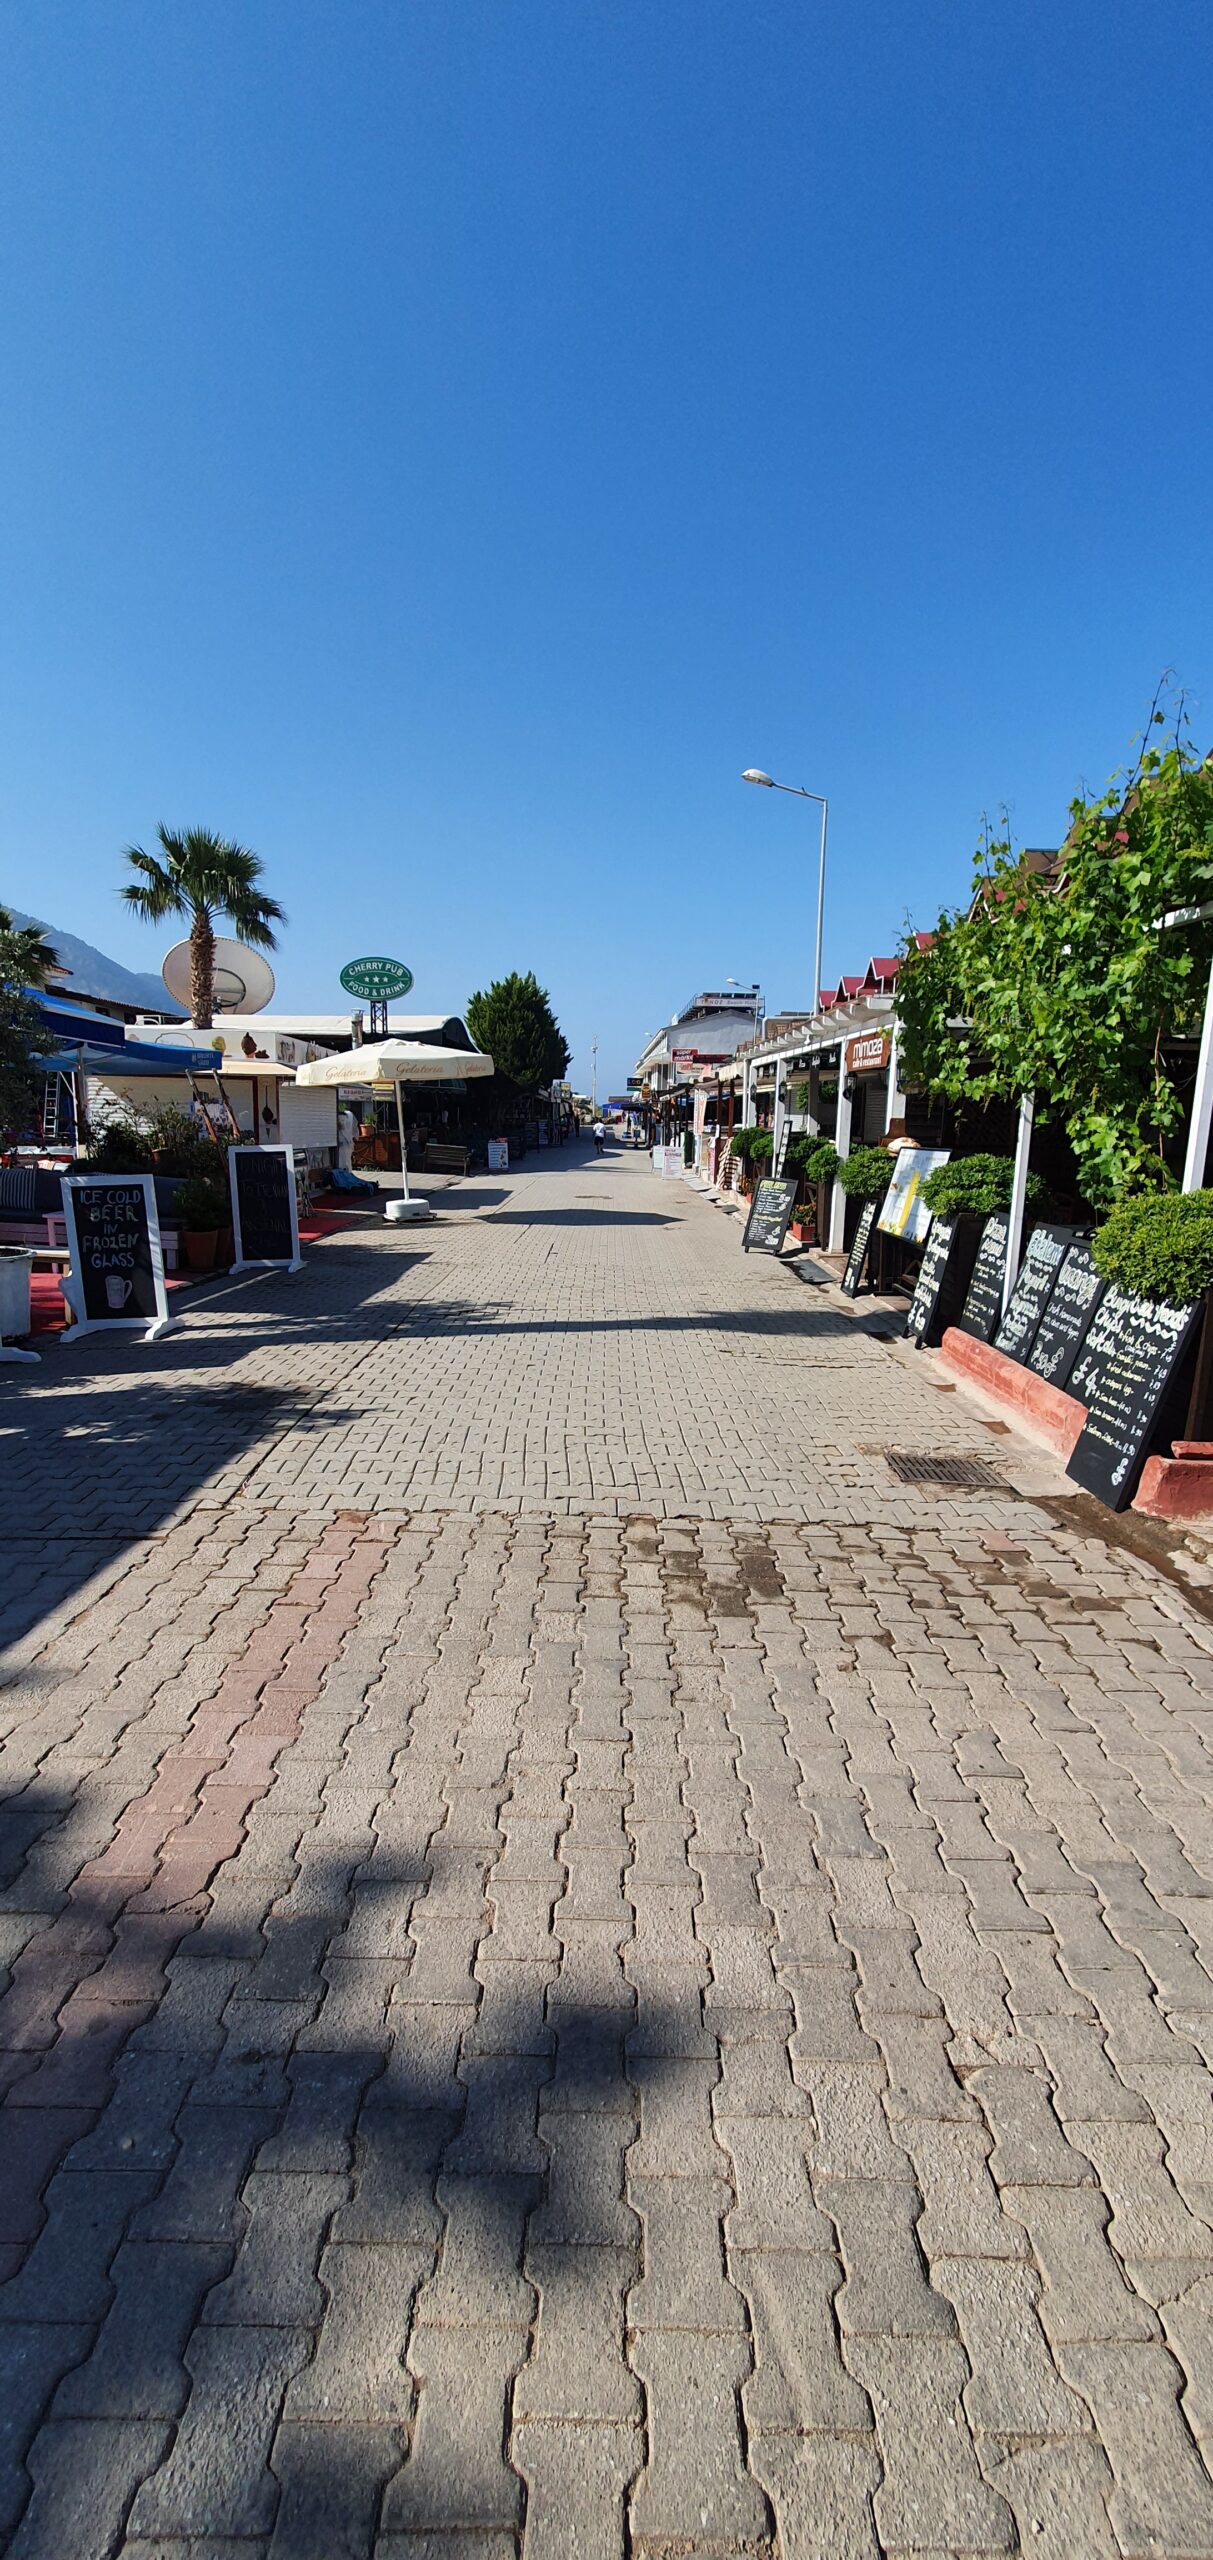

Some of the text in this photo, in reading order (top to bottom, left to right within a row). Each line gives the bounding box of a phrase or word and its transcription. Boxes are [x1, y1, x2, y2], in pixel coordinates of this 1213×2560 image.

[348, 962, 404, 976] CHERRY PUB
[348, 981, 370, 995] FOOD
[380, 982, 405, 996] DRINK
[853, 1038, 883, 1060] mimoza
[325, 1067, 367, 1082] Gelateria
[396, 1062, 445, 1077] Gelateria
[80, 1190, 141, 1205] ICE COLD
[90, 1205, 140, 1222] BEER
[103, 1223, 119, 1235] IN
[82, 1233, 140, 1253] FROZEN
[91, 1252, 135, 1269] GLASS
